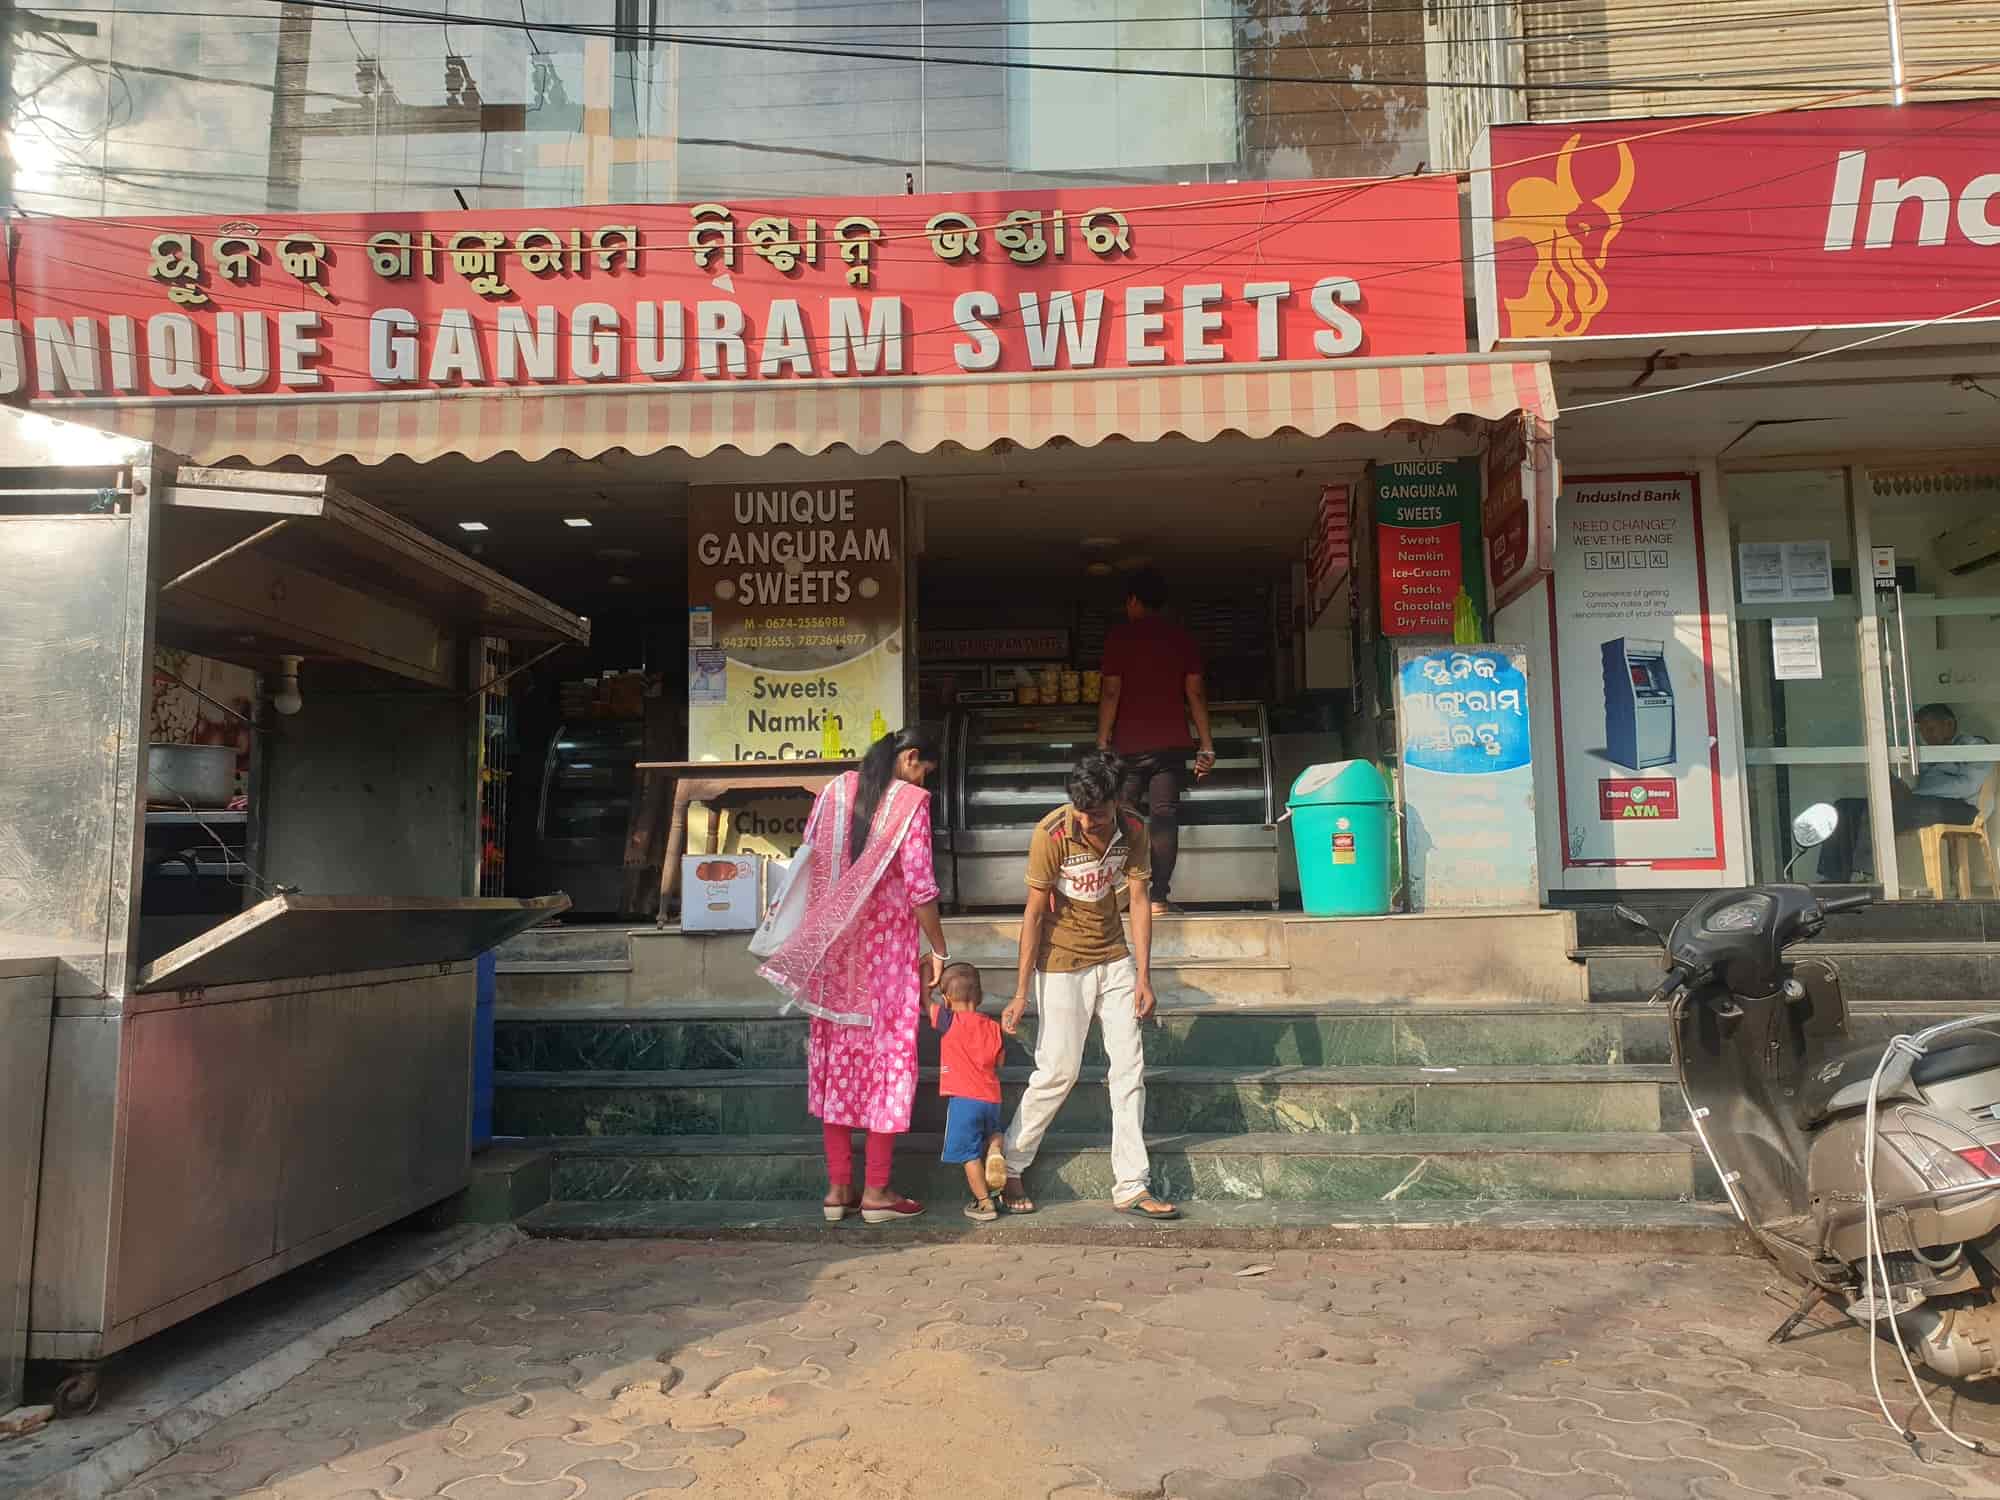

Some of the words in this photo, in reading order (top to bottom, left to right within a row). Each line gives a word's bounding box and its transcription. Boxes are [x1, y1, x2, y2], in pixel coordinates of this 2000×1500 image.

[927, 207, 1130, 263] ଭଣ୍ଡାର
[369, 296, 902, 383] GANGURAM
[953, 277, 1362, 371] SWEETS
[1394, 463, 1443, 476] UNIQUE
[1380, 485, 1457, 499] GANGURAM
[1576, 490, 1640, 504] IndusInd
[1644, 489, 1680, 502] Bank
[734, 489, 855, 525] UNIQUE
[1397, 507, 1442, 520] SWEETS
[1572, 519, 1609, 533] NEED
[1612, 518, 1676, 532] CHANGE?
[1400, 535, 1441, 545] Sweets
[1611, 535, 1632, 545] THE
[1634, 535, 1673, 545] RANGE
[698, 528, 891, 566] GANGURAM
[1398, 551, 1444, 561] Namkin
[1590, 556, 1598, 567] S
[1610, 556, 1620, 565] M
[1635, 556, 1641, 565] L
[1652, 555, 1665, 565] XL
[1392, 568, 1451, 579] Ice-Cream
[737, 570, 851, 605] SWEETS
[1401, 584, 1442, 595] Snacks
[1394, 601, 1451, 611] Chocolate
[1398, 617, 1416, 627] Dry
[1420, 616, 1449, 626] Fruits
[753, 676, 838, 699] Sweets
[1622, 805, 1660, 817] ATM
